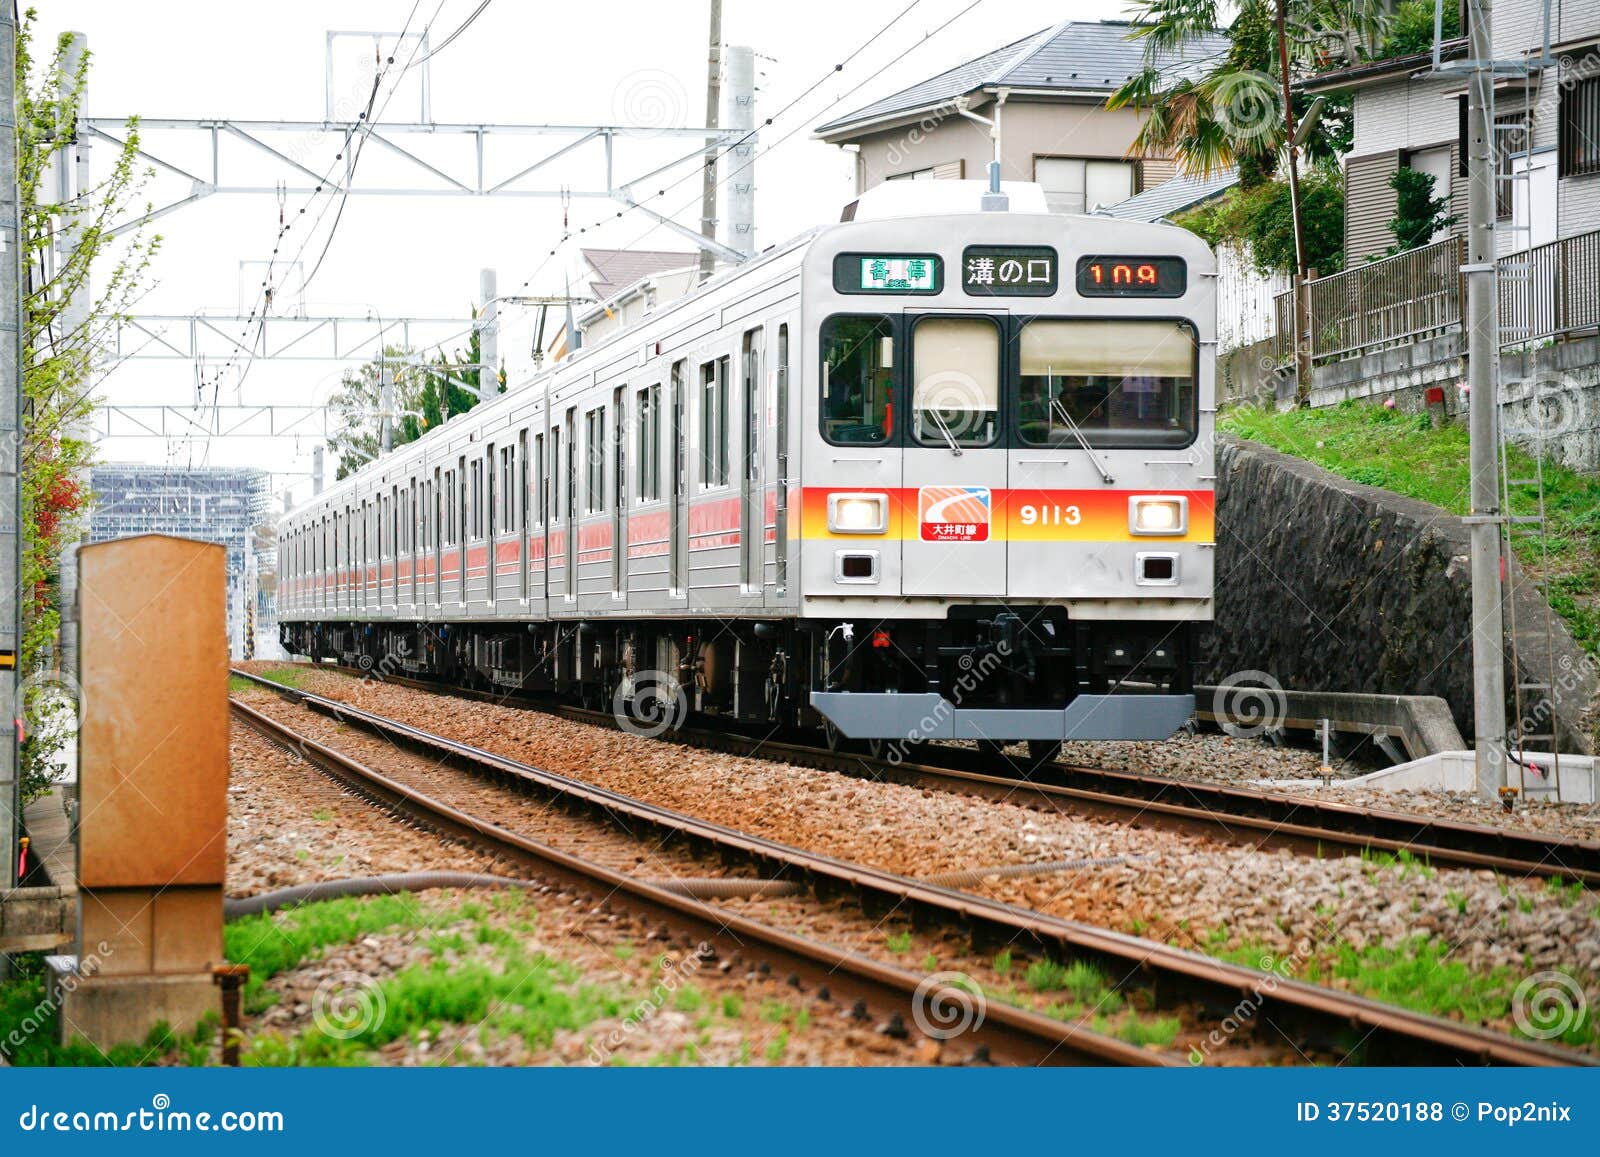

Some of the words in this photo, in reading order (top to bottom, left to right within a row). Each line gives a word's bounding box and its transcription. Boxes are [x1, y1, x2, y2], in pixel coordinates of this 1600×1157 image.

[967, 257, 1051, 284] 溝の口
[1020, 505, 1082, 525] 9113
[933, 524, 977, 536] 大井町線
